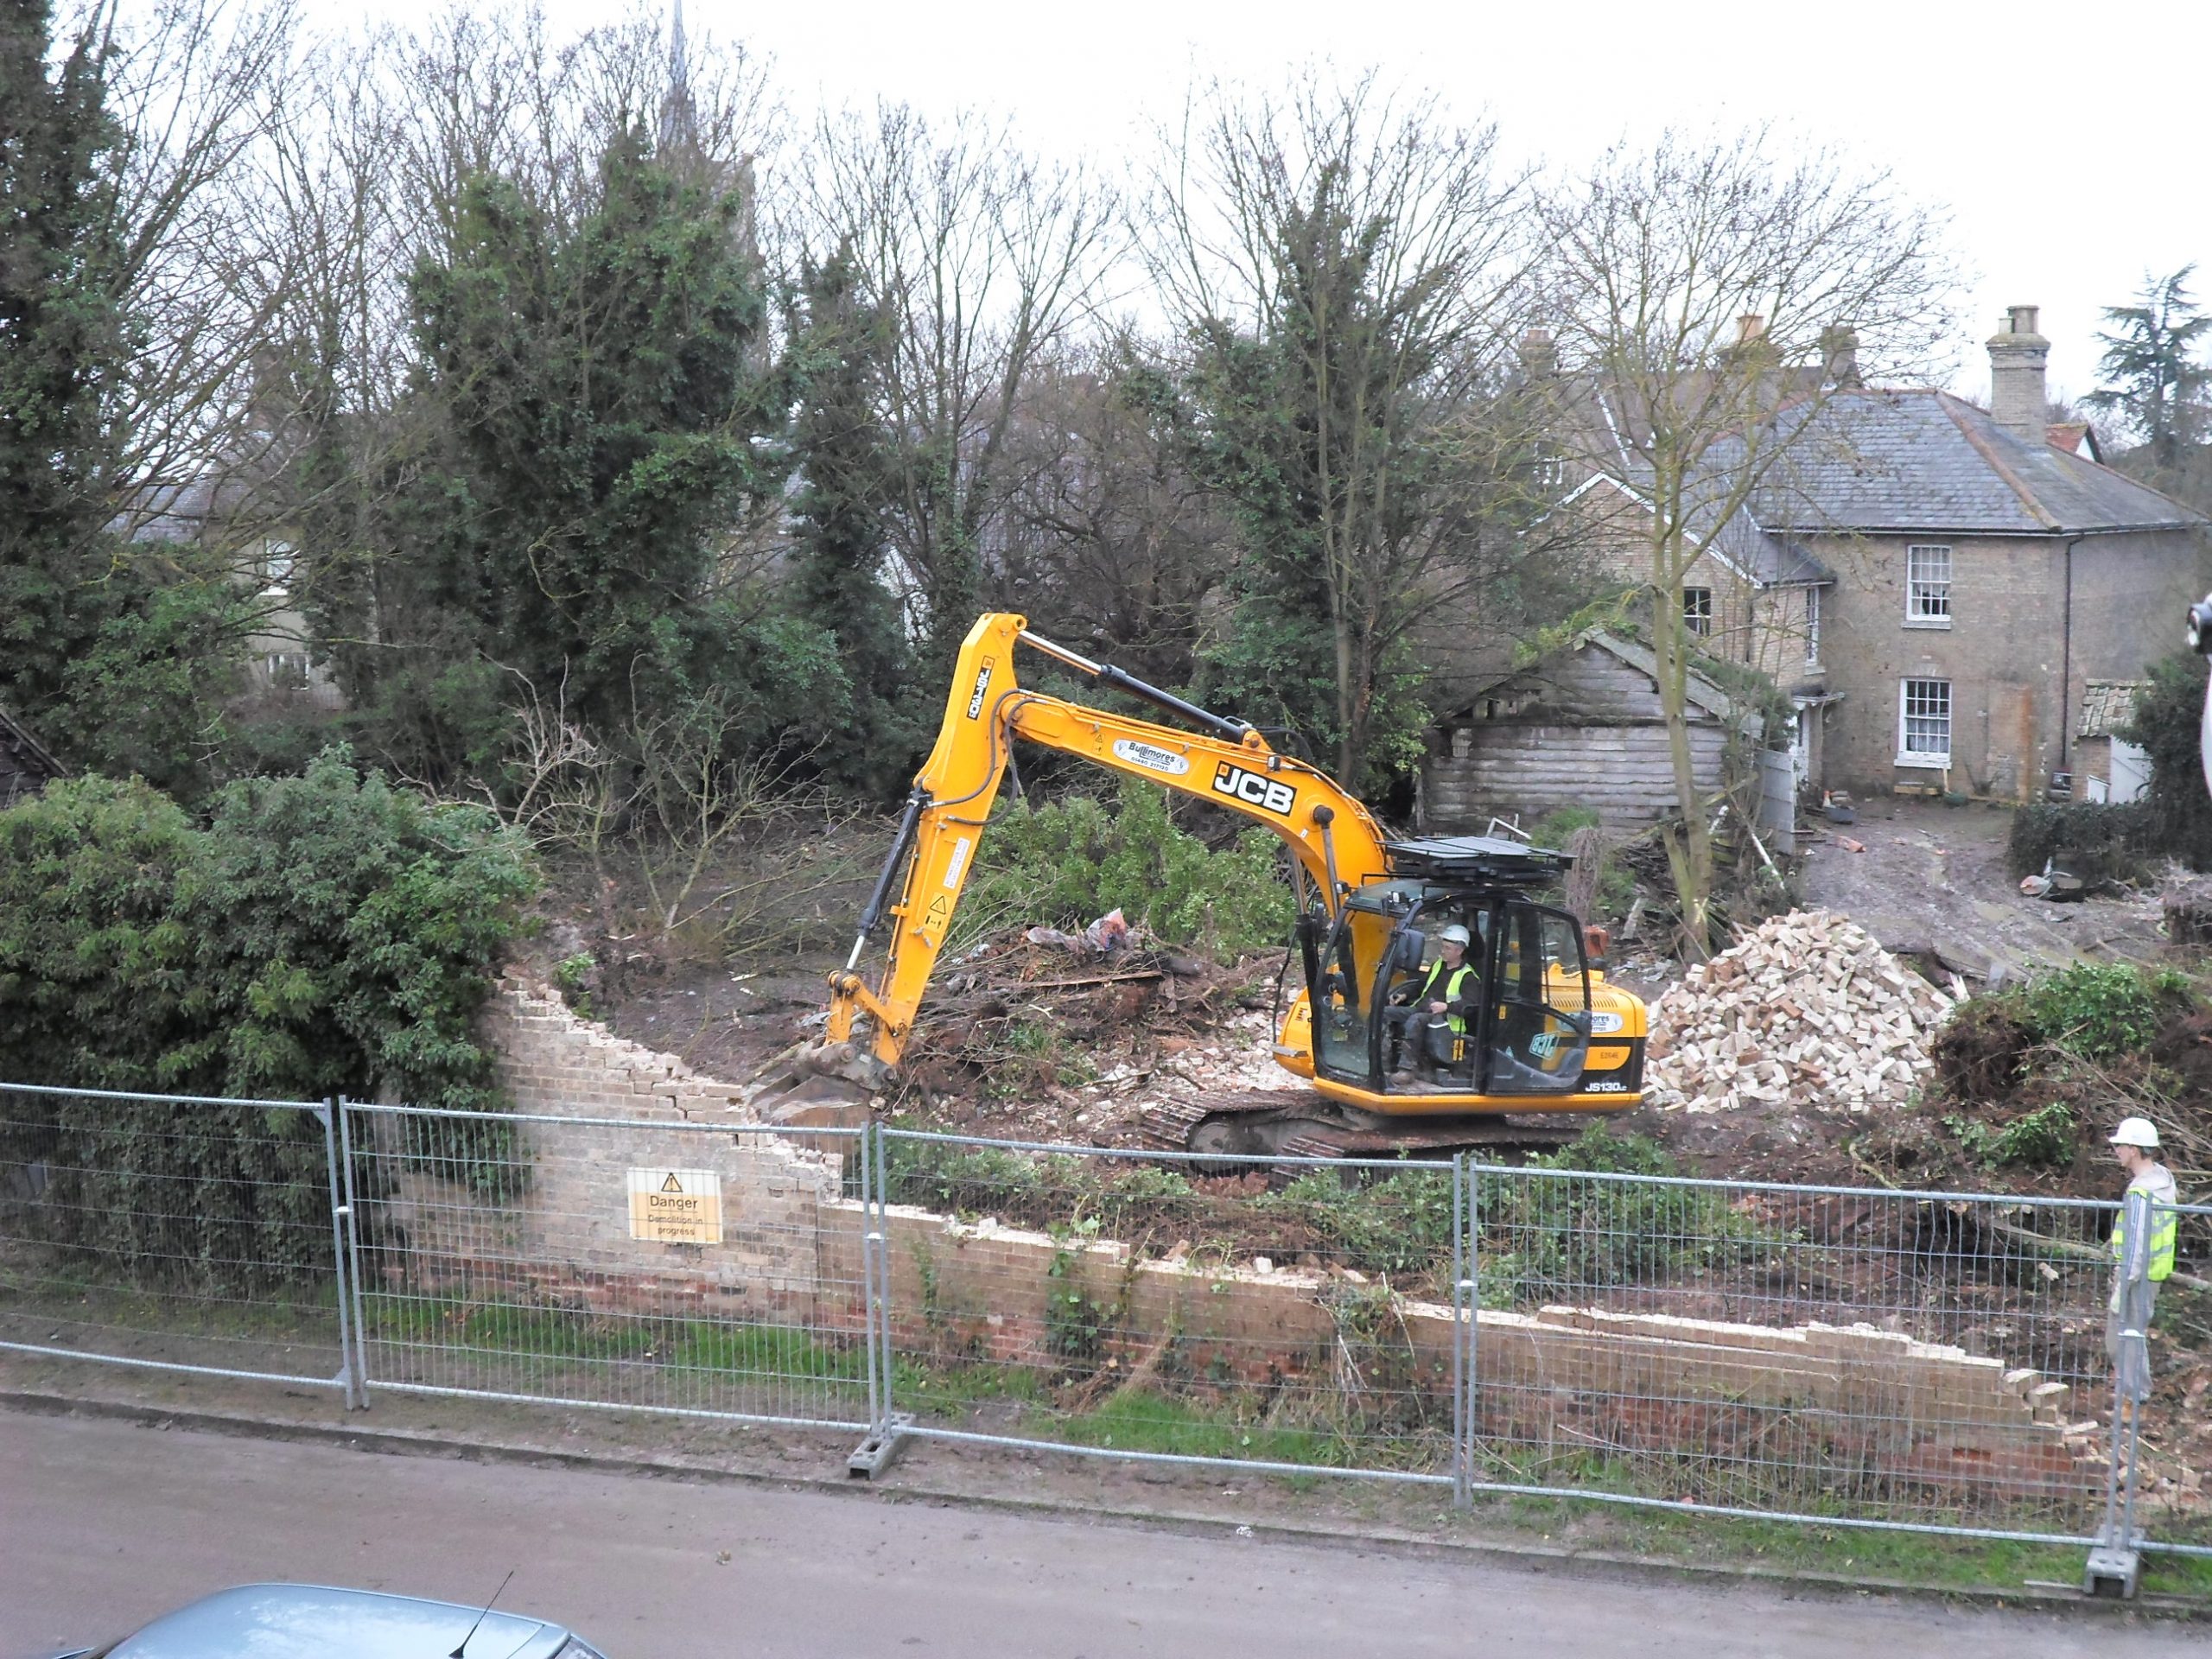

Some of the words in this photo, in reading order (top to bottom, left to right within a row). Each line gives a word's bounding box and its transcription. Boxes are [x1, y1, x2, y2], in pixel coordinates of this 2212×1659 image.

[1128, 742, 1175, 764] Bullimores
[1214, 768, 1294, 813] JCB
[650, 1195, 698, 1210] Danger
[648, 1214, 694, 1224] Demolition
[695, 1217, 703, 1225] in
[658, 1227, 696, 1236] progress
